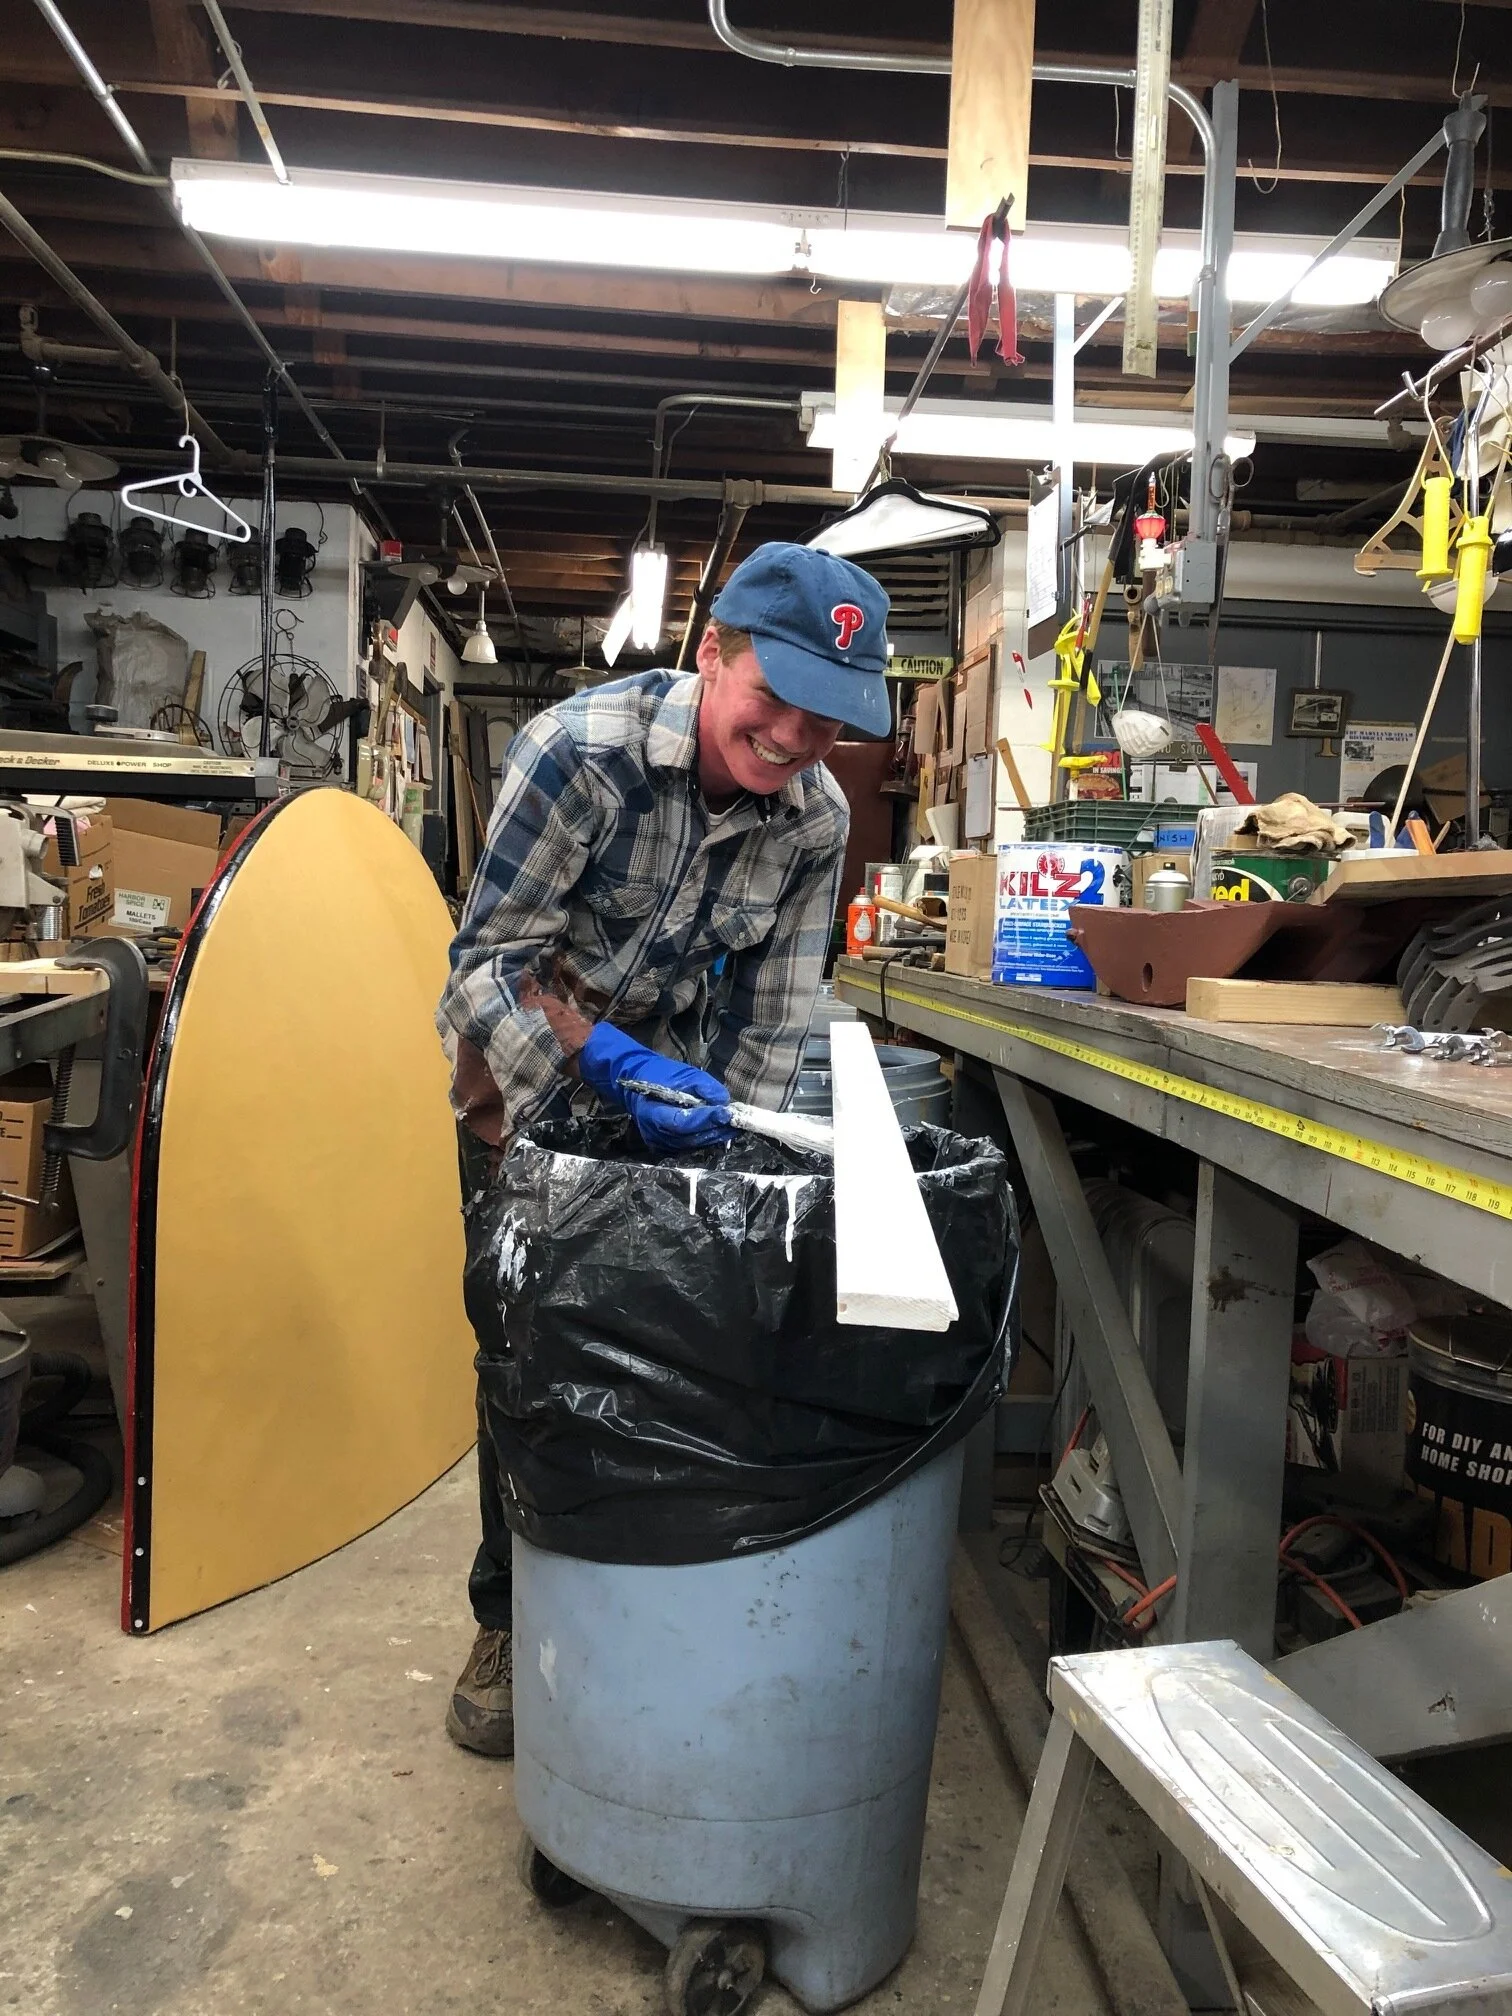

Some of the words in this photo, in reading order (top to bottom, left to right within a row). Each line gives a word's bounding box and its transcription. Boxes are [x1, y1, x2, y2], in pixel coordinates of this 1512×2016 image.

[831, 604, 864, 650] P
[901, 659, 943, 675] CAUTION
[25, 755, 60, 766] Decker
[1159, 834, 1187, 843] NISH
[86, 882, 105, 902] Fresh
[1000, 871, 1081, 898] KILZ
[1074, 859, 1105, 905] 2
[79, 893, 111, 922] Tomatoes
[118, 892, 146, 903] HARBOR
[125, 899, 145, 907] SPICE
[1000, 898, 1080, 912] LATEX
[126, 910, 157, 921] MALLETS
[1371, 1157, 1380, 1167] 113
[1388, 1163, 1398, 1172] 114
[1406, 1169, 1416, 1179] 115
[1425, 1176, 1435, 1187] 116
[1445, 1183, 1456, 1194] 117
[1465, 1190, 1478, 1202] 118
[1487, 1198, 1500, 1210] 119
[1422, 1422, 1446, 1445] FOR
[1451, 1433, 1483, 1455] DIY
[1421, 1444, 1460, 1472] HOME
